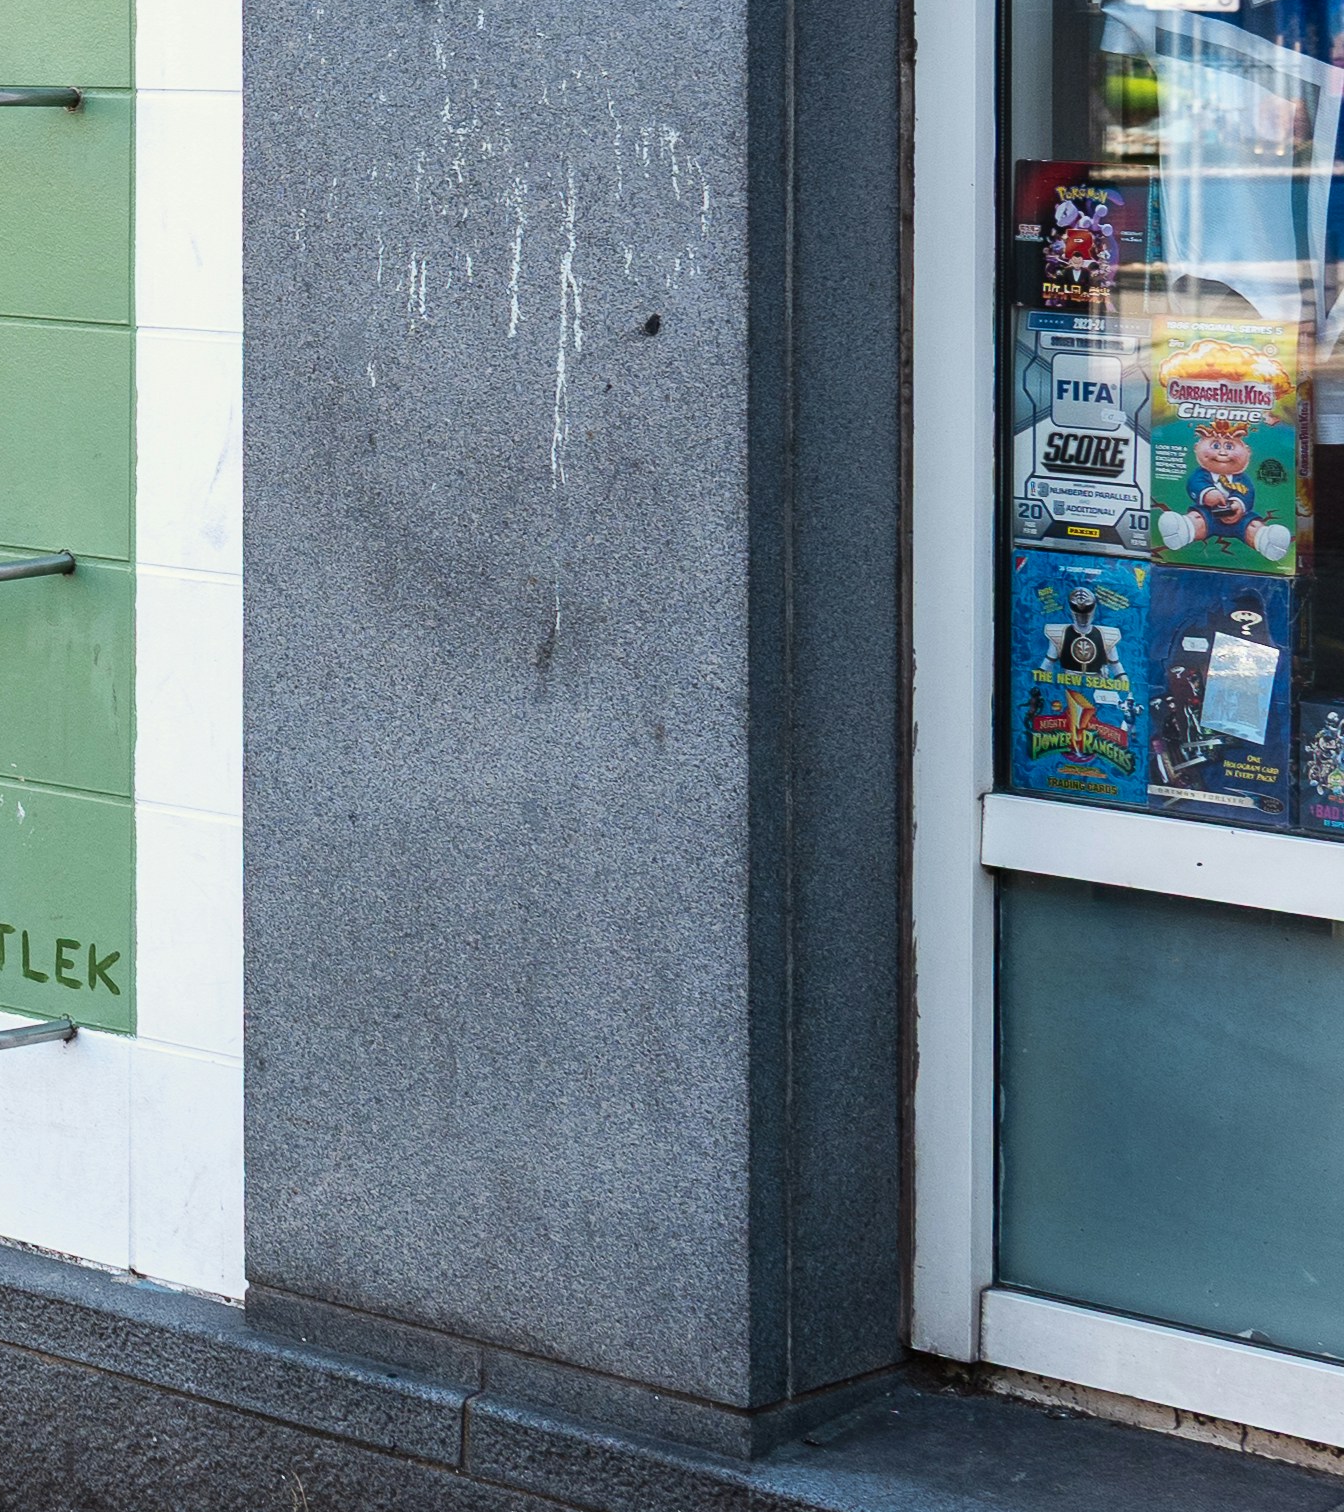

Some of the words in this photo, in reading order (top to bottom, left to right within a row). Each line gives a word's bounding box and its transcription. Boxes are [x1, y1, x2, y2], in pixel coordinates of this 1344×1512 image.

[1057, 380, 1114, 404] FIFA
[1178, 403, 1262, 423] Chrome
[1043, 432, 1130, 468] SCORE
[1018, 503, 1043, 520] 20
[1129, 514, 1149, 531] 10
[1032, 670, 1053, 683] THE
[1057, 674, 1082, 686] NEW
[1086, 676, 1130, 691] SEASON
